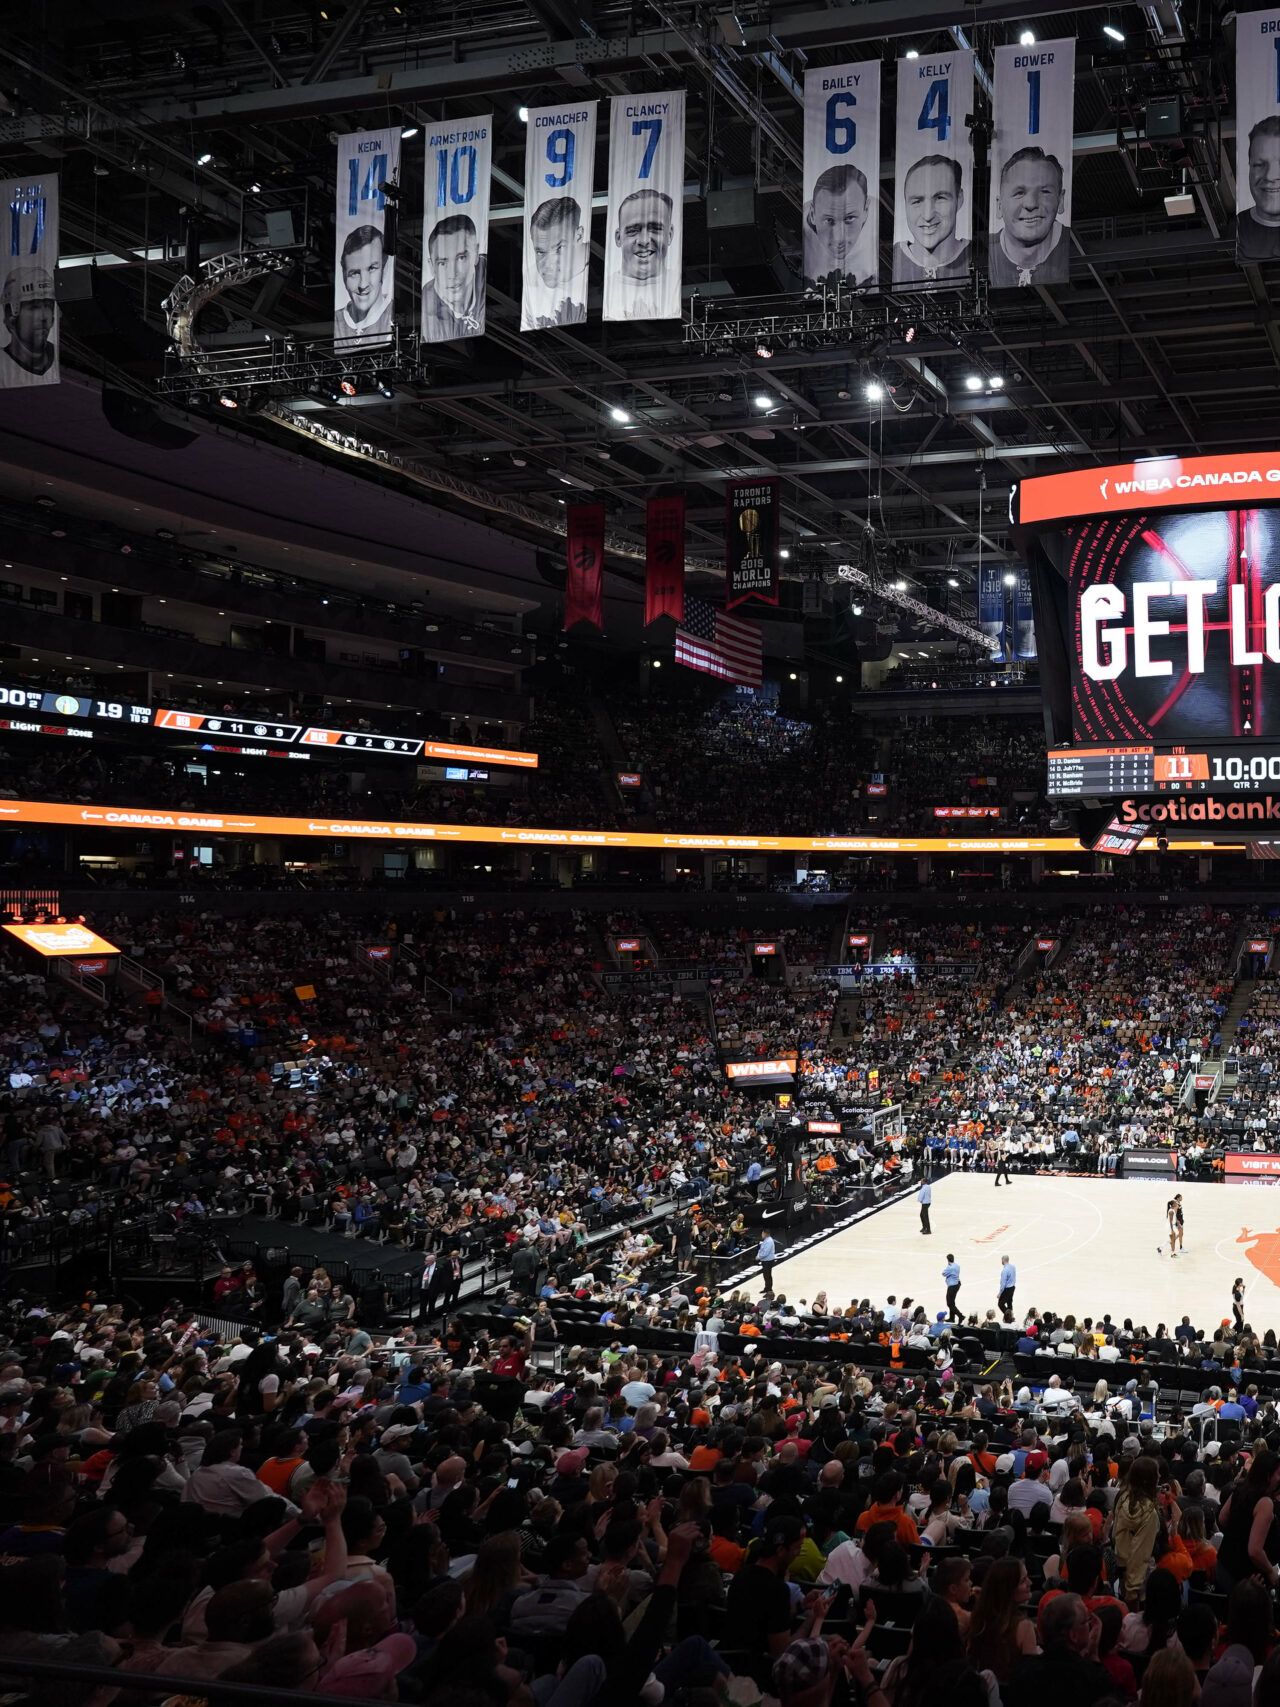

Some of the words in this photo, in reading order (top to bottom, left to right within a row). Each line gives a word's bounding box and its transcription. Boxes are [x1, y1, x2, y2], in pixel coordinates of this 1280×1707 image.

[1014, 53, 1055, 68] BOWER
[919, 63, 952, 79] KELLY
[822, 75, 860, 91] BAILEY
[626, 103, 669, 118] CLANCY
[918, 78, 951, 142] 4
[1027, 70, 1041, 135] 1
[536, 111, 588, 128] CONACHER
[825, 92, 857, 154] 6
[430, 129, 486, 147] ARMSTRONG
[358, 140, 381, 154] KEON
[632, 119, 662, 179] 7
[545, 128, 575, 188] 9
[437, 145, 477, 208] 10
[349, 154, 388, 216] 14
[10, 198, 46, 256] 17
[1114, 478, 1172, 494] WNBA
[1175, 471, 1262, 488] CANADA
[734, 486, 771, 498] TORONTO
[733, 496, 771, 507] RAPTORS
[741, 559, 764, 570] 2019
[733, 567, 771, 581] WORLD
[733, 580, 771, 590] CHAMPIONS
[1080, 579, 1217, 681] GET
[29, 700, 38, 708] 2
[96, 701, 122, 718] 19
[10, 721, 41, 732] LIGHT
[67, 728, 93, 738] ZONE
[231, 723, 243, 733] 11
[276, 729, 283, 737] 9
[402, 743, 408, 751] 4
[1167, 757, 1193, 778] 11
[105, 811, 175, 825] CANADA
[178, 817, 223, 828] GAME
[330, 824, 391, 835] CANADA
[395, 827, 435, 837] GAME
[731, 1061, 791, 1076] WNBA
[804, 1100, 827, 1108] Scene
[810, 1122, 838, 1131] WNBA
[1128, 1157, 1168, 1165] WNBA.COM
[1242, 1161, 1269, 1169] VISIT
[775, 1227, 838, 1260] CANADA
